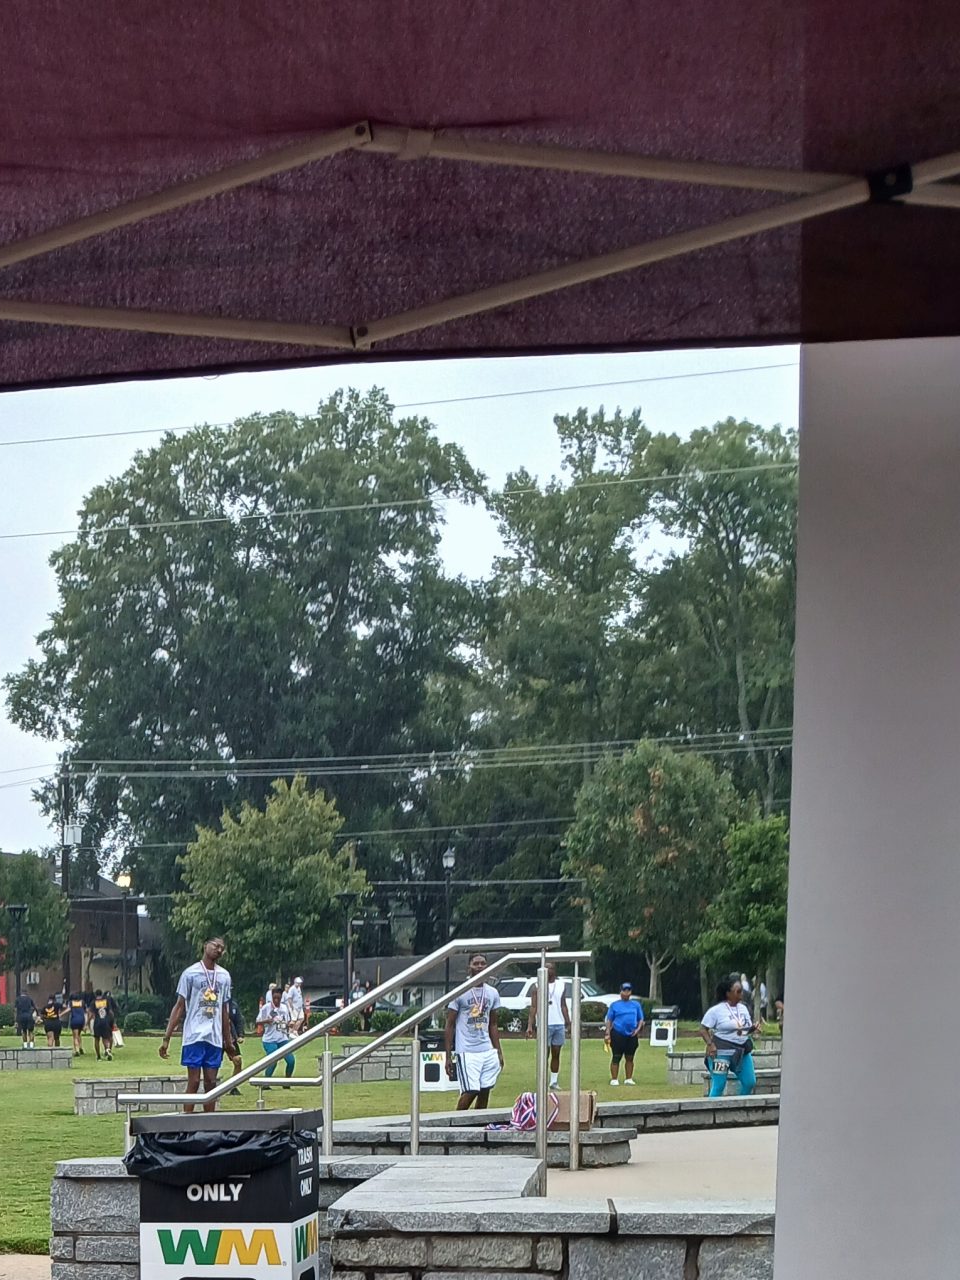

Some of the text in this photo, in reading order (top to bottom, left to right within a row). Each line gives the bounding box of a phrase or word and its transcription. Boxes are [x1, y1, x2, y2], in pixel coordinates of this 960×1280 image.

[422, 1053, 443, 1061] WM
[297, 1145, 313, 1166] TRASH
[186, 1182, 243, 1202] ONLY
[300, 1176, 313, 1197] ONLY
[156, 1229, 282, 1266] WM
[295, 1217, 318, 1263] WM
